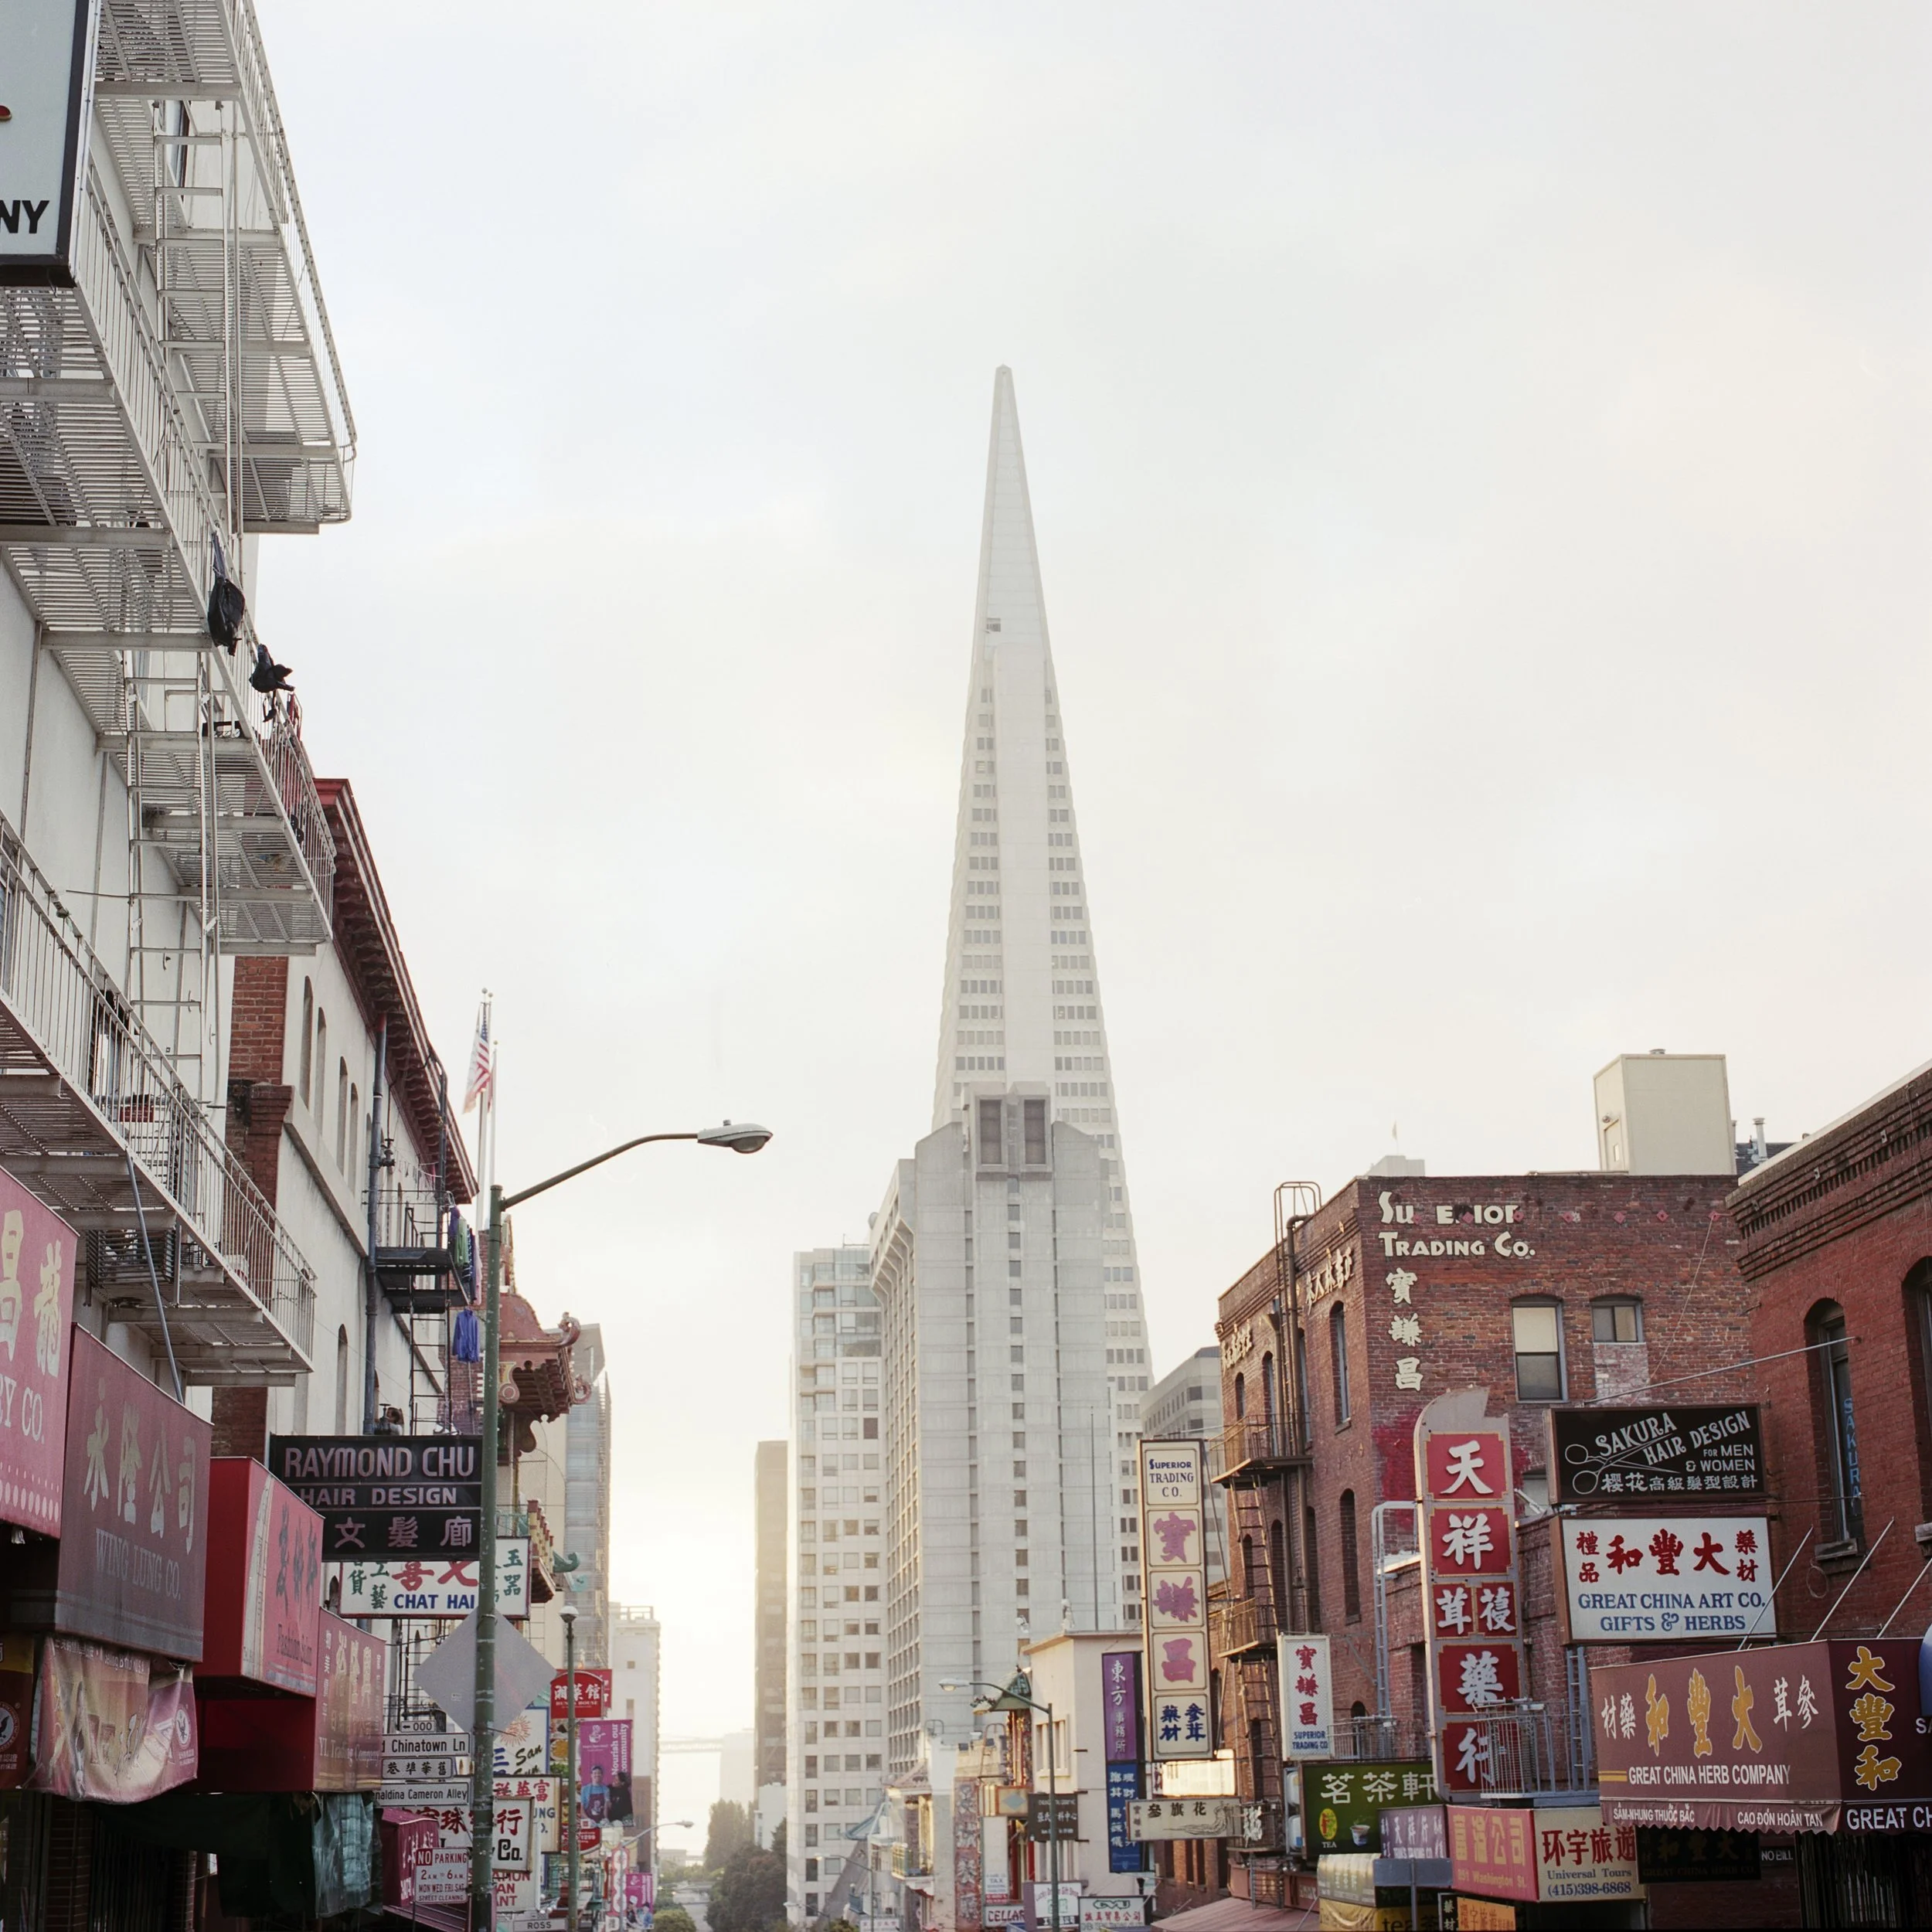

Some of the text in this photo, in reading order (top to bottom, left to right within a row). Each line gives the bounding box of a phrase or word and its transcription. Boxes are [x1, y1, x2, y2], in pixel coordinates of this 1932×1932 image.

[1379, 1230, 1536, 1258] TRADING CO.
[1595, 1412, 1677, 1457] SAKURA
[1643, 1410, 1751, 1465] HAIR DESIGN
[1703, 1444, 1753, 1458] FOR MEN
[284, 1446, 474, 1478] RAYMOND CHU
[1148, 1458, 1192, 1471] SUPERIOR
[1685, 1459, 1756, 1471] & WOMEN
[1149, 1472, 1194, 1484] TRADING
[300, 1487, 457, 1505] HAIR DESIGN
[1162, 1487, 1182, 1498] CO.
[96, 1528, 129, 1580] WING
[131, 1545, 162, 1593] LUNG
[394, 1594, 439, 1609] CHAT
[1578, 1592, 1766, 1610] GREAT CHINA ART CO.
[1600, 1612, 1746, 1631] GIFTS & HERBS
[413, 1723, 433, 1731] 000
[1294, 1730, 1325, 1740] SUPERIOR
[392, 1739, 447, 1753] Chinatown
[453, 1738, 465, 1751] Ln
[1292, 1740, 1318, 1750] TRADING
[515, 1744, 543, 1767] San
[1628, 1764, 1791, 1786] GREAT CHINA HERB COMPANY
[408, 1789, 444, 1799] Cameron
[447, 1788, 468, 1801] Alley
[1737, 1811, 1756, 1825] CAO
[1846, 1807, 1907, 1830] GREAT
[498, 1838, 522, 1861] Co.
[1761, 1851, 1774, 1861] NO
[417, 1851, 467, 1865] NO PARKING
[420, 1869, 427, 1880] 2
[447, 1869, 453, 1879] 6
[1547, 1868, 1632, 1880] Universal Tours
[418, 1884, 430, 1893] MON
